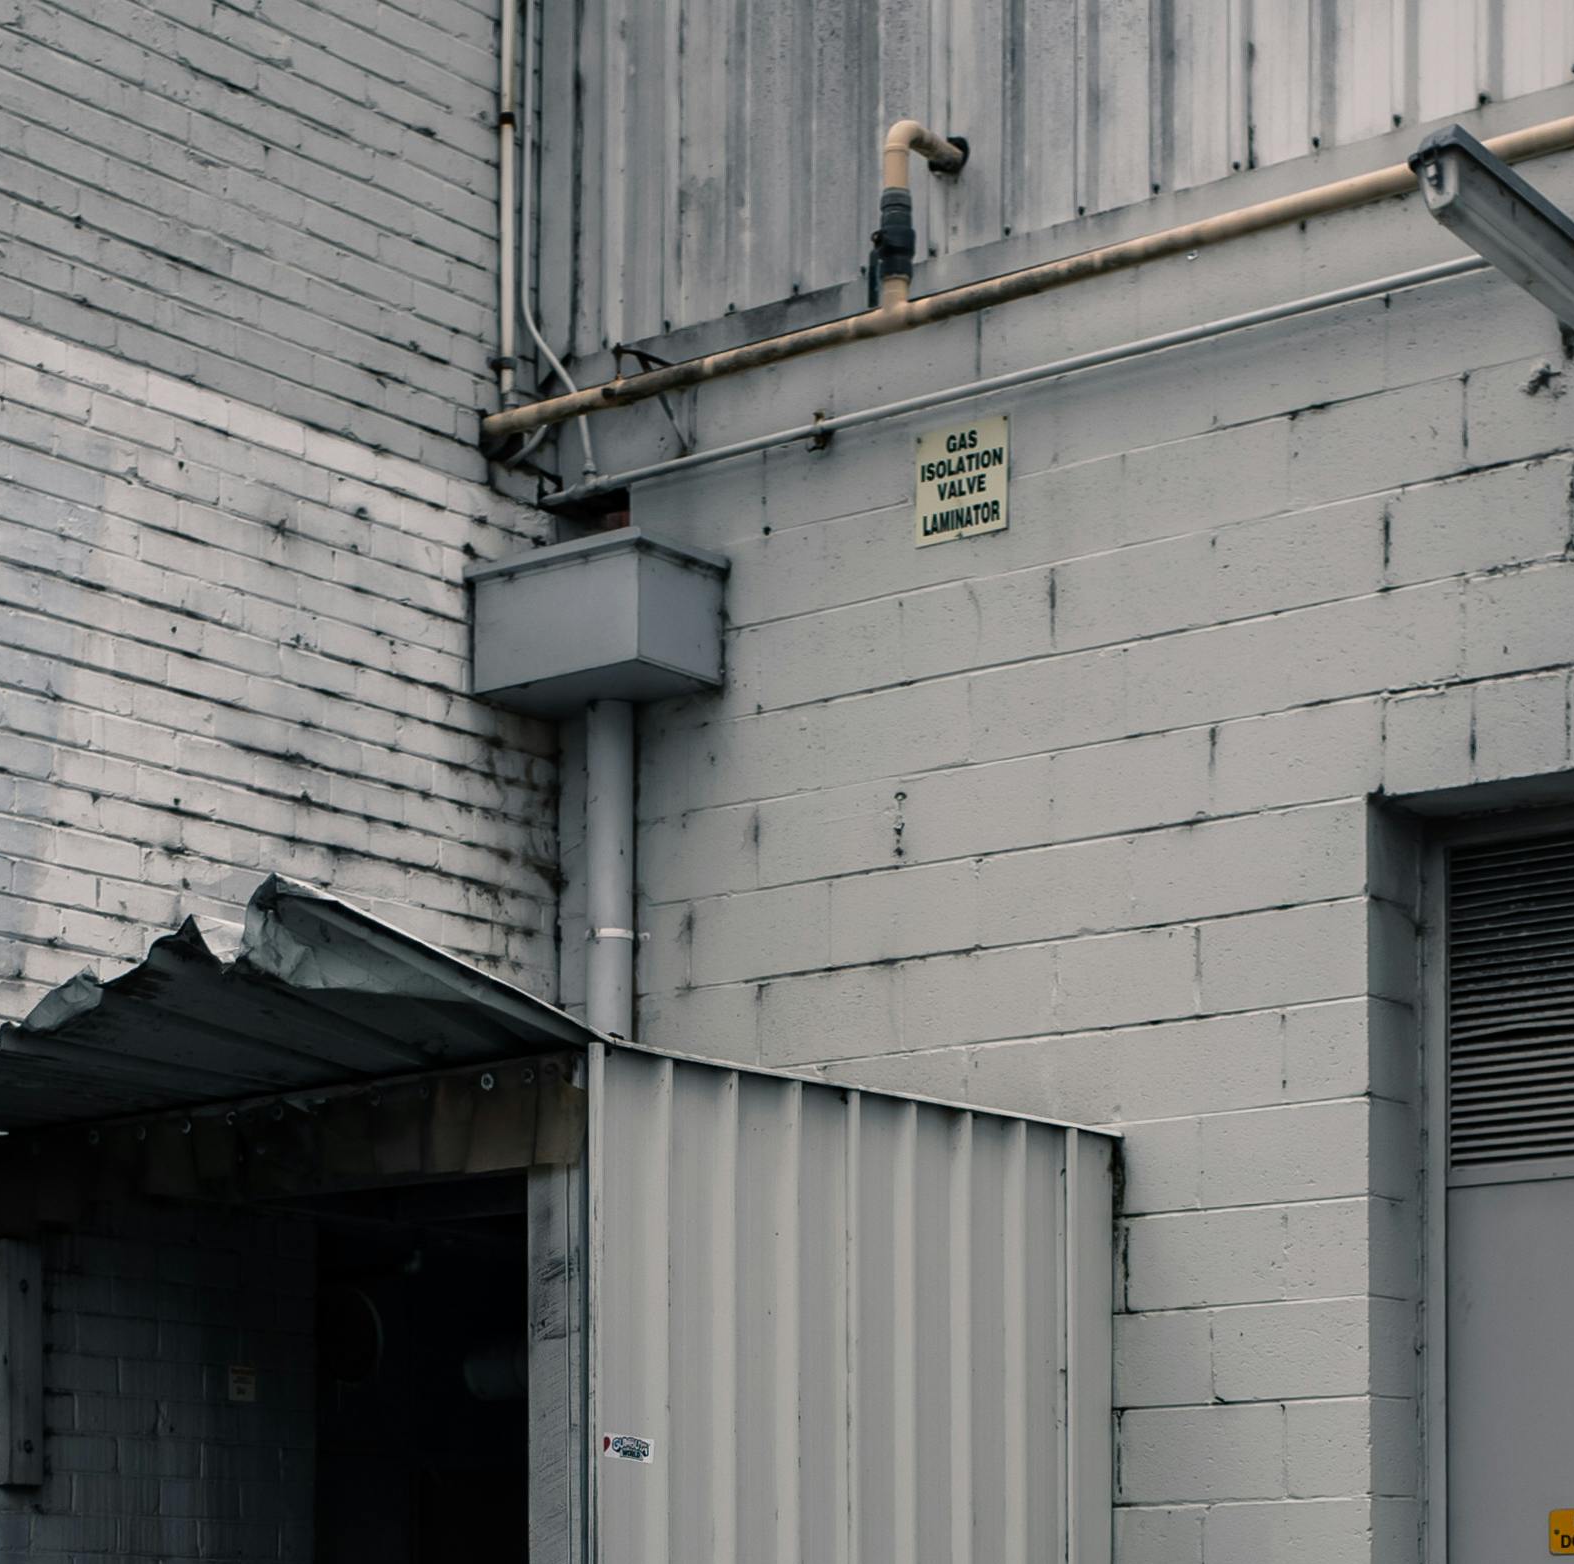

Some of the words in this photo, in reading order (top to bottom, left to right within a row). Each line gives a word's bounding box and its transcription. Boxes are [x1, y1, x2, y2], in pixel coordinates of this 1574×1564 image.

[946, 430, 978, 453] GAS
[921, 447, 1004, 482] ISOLATION
[937, 474, 986, 501] VALVE
[923, 500, 1000, 536] LAMINATOR
